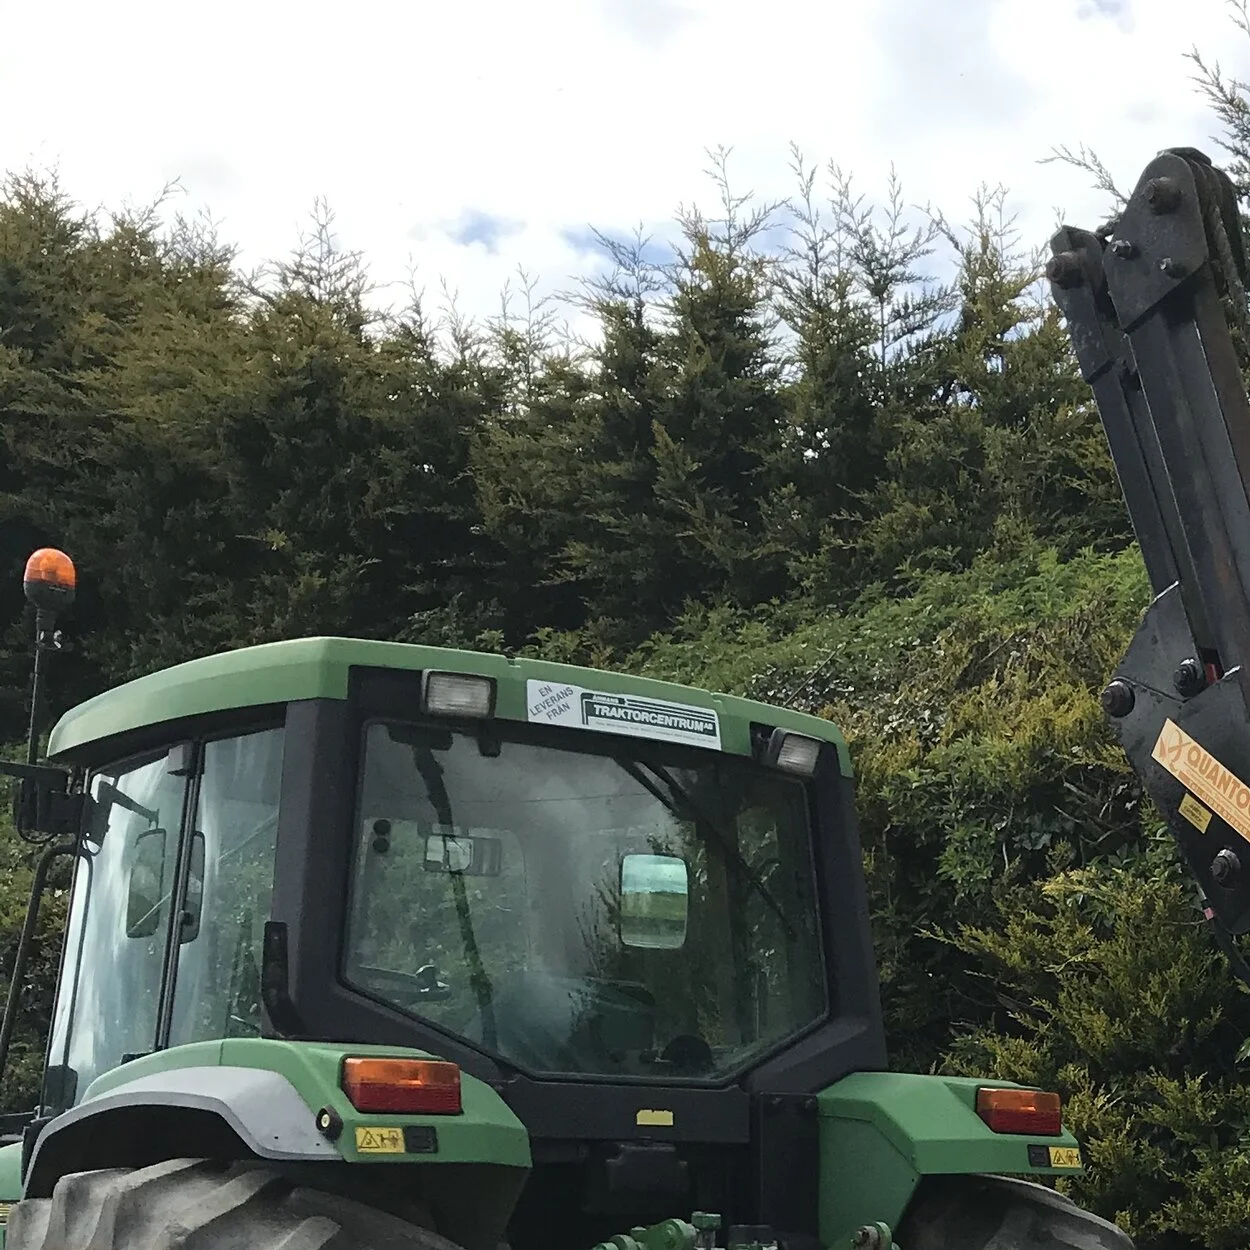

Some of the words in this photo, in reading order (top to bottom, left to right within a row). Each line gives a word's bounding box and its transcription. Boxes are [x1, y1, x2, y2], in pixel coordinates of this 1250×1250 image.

[530, 687, 574, 716] LEVERANS
[539, 685, 553, 697] EN
[593, 705, 704, 732] TRAKTORCENTRUM
